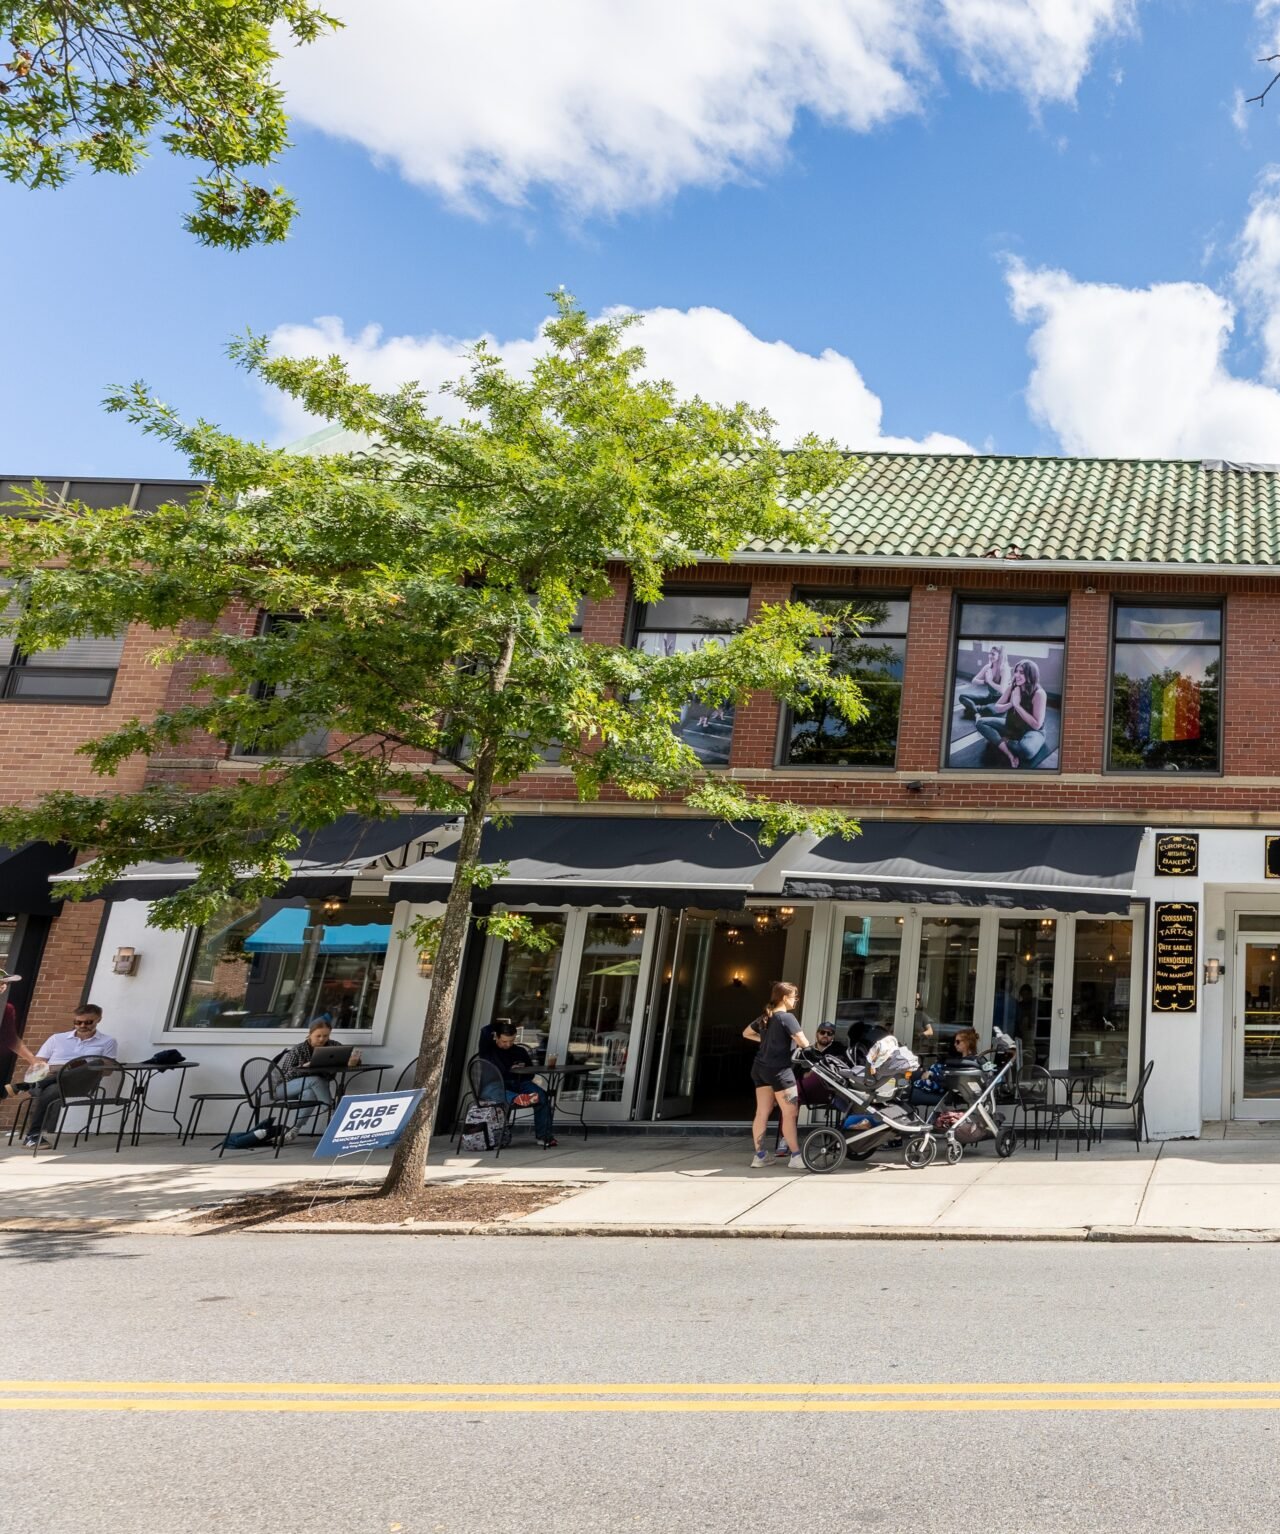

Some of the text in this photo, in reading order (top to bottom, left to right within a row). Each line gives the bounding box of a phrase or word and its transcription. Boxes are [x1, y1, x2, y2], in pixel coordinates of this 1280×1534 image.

[1160, 843, 1196, 852] EUROPEAN
[1162, 857, 1191, 865] BAKERY
[1161, 914, 1193, 922] CROISSANTS
[1159, 928, 1194, 937] TARTAS
[1158, 956, 1194, 965] VIENNOISERIE
[350, 1104, 399, 1119] GABE
[342, 1118, 382, 1132] AMO
